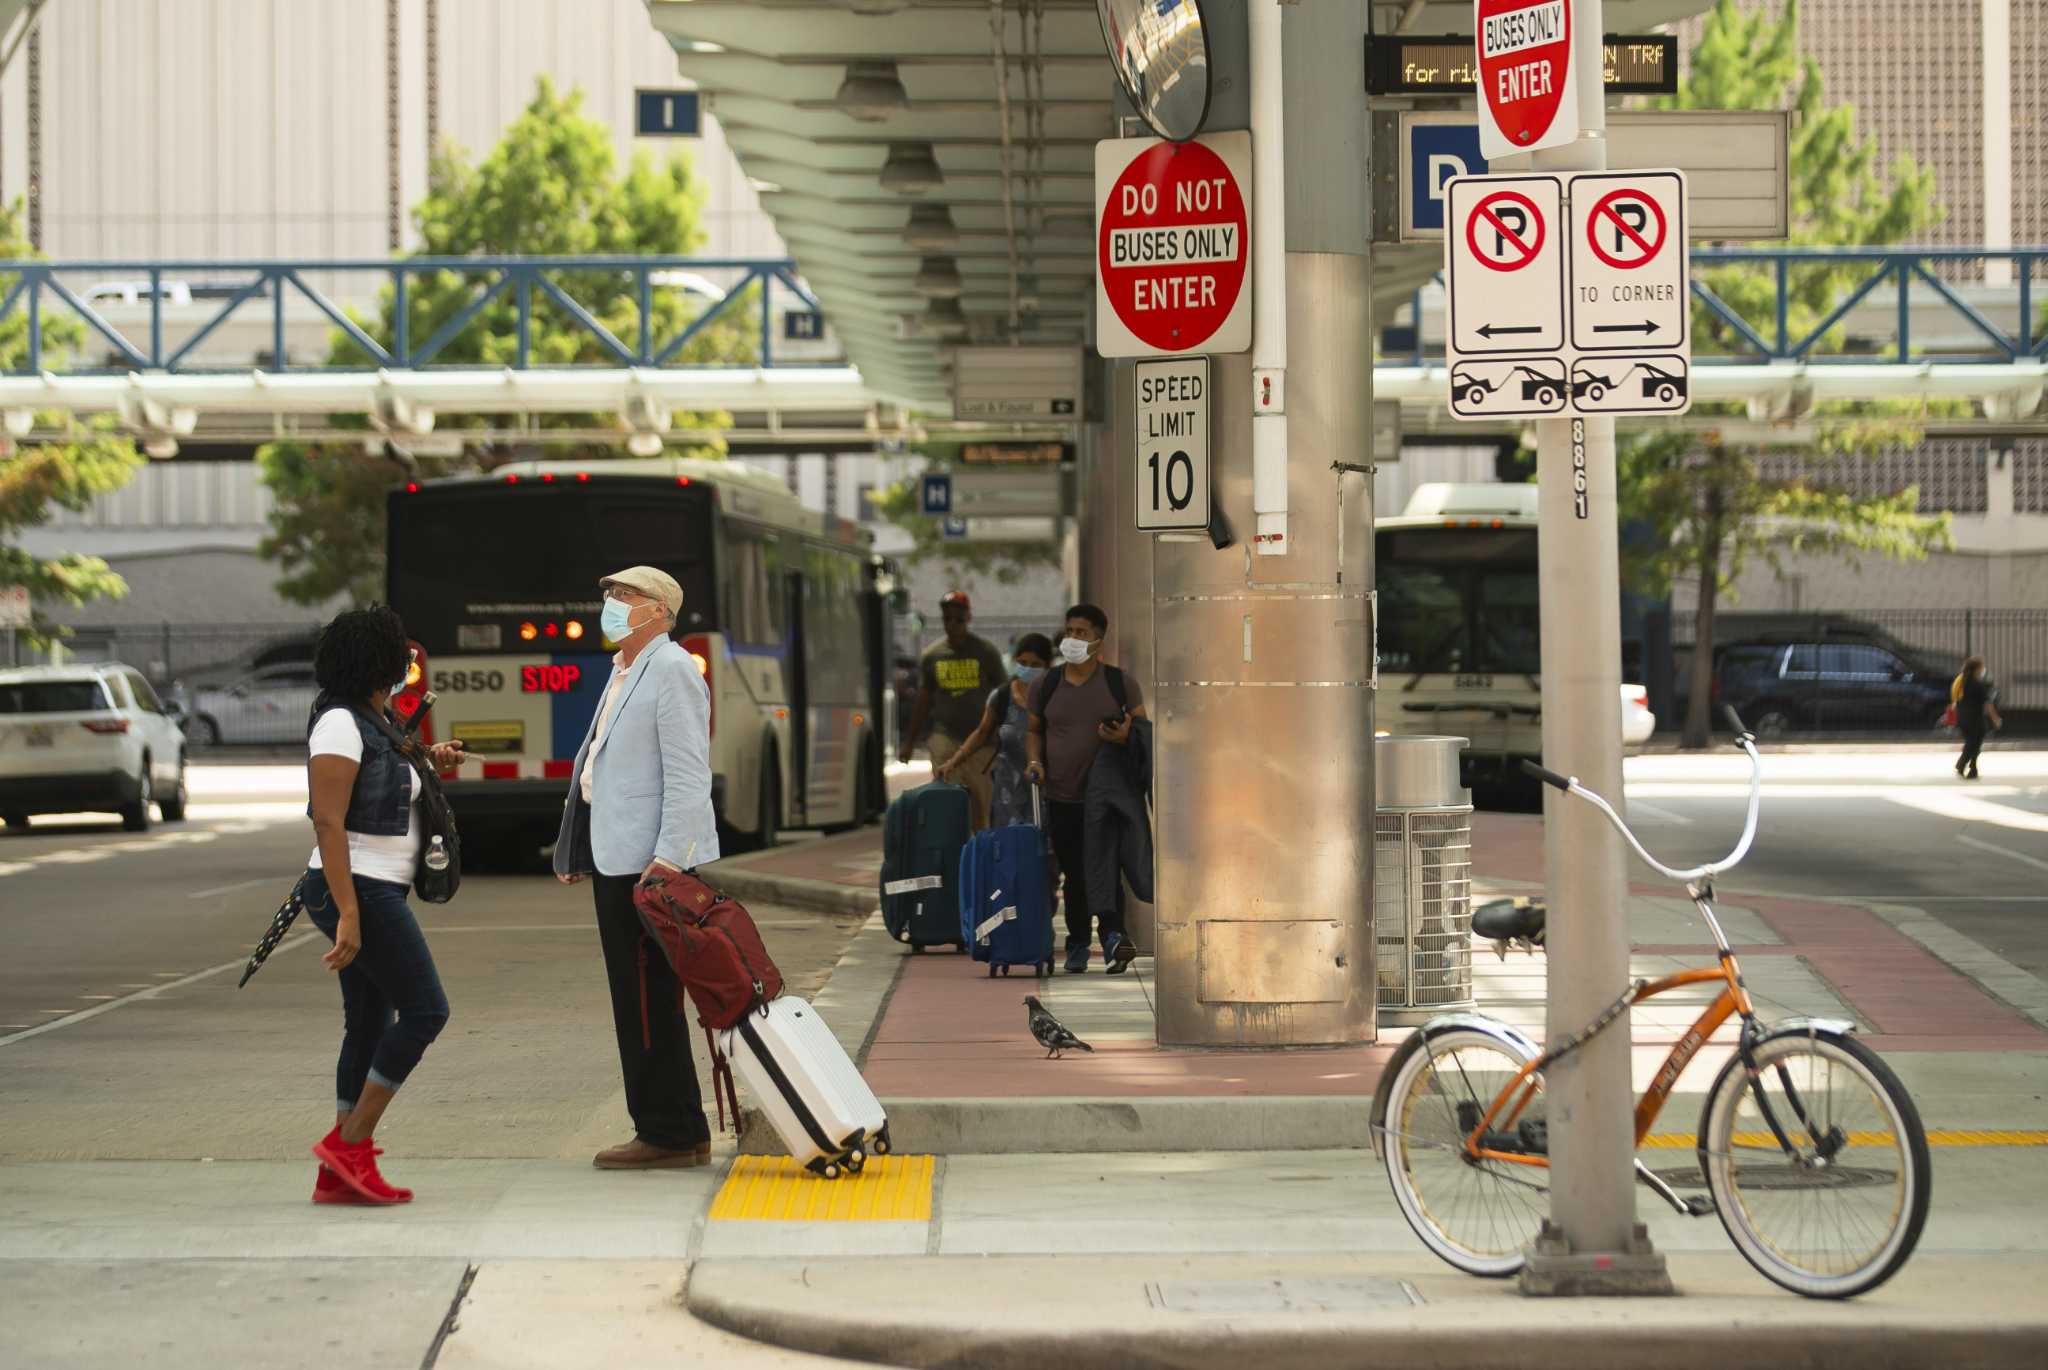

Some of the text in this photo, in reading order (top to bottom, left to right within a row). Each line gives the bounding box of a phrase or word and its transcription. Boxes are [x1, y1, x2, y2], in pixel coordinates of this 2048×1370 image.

[1487, 5, 1560, 53] BUSES ONLY
[1404, 63, 1440, 82] for
[1498, 59, 1552, 104] ENTER
[1122, 178, 1227, 217] DO NOT
[1114, 227, 1234, 262] BUSES ONLY
[1134, 275, 1216, 312] ENTER
[1580, 284, 1675, 303] TO CORNER
[1141, 375, 1203, 404] SPEED
[1148, 411, 1196, 438] LIMIT
[1148, 450, 1194, 512] 10
[1573, 420, 1586, 517] 8861
[433, 670, 504, 692] 5850
[521, 664, 580, 693] STOP
